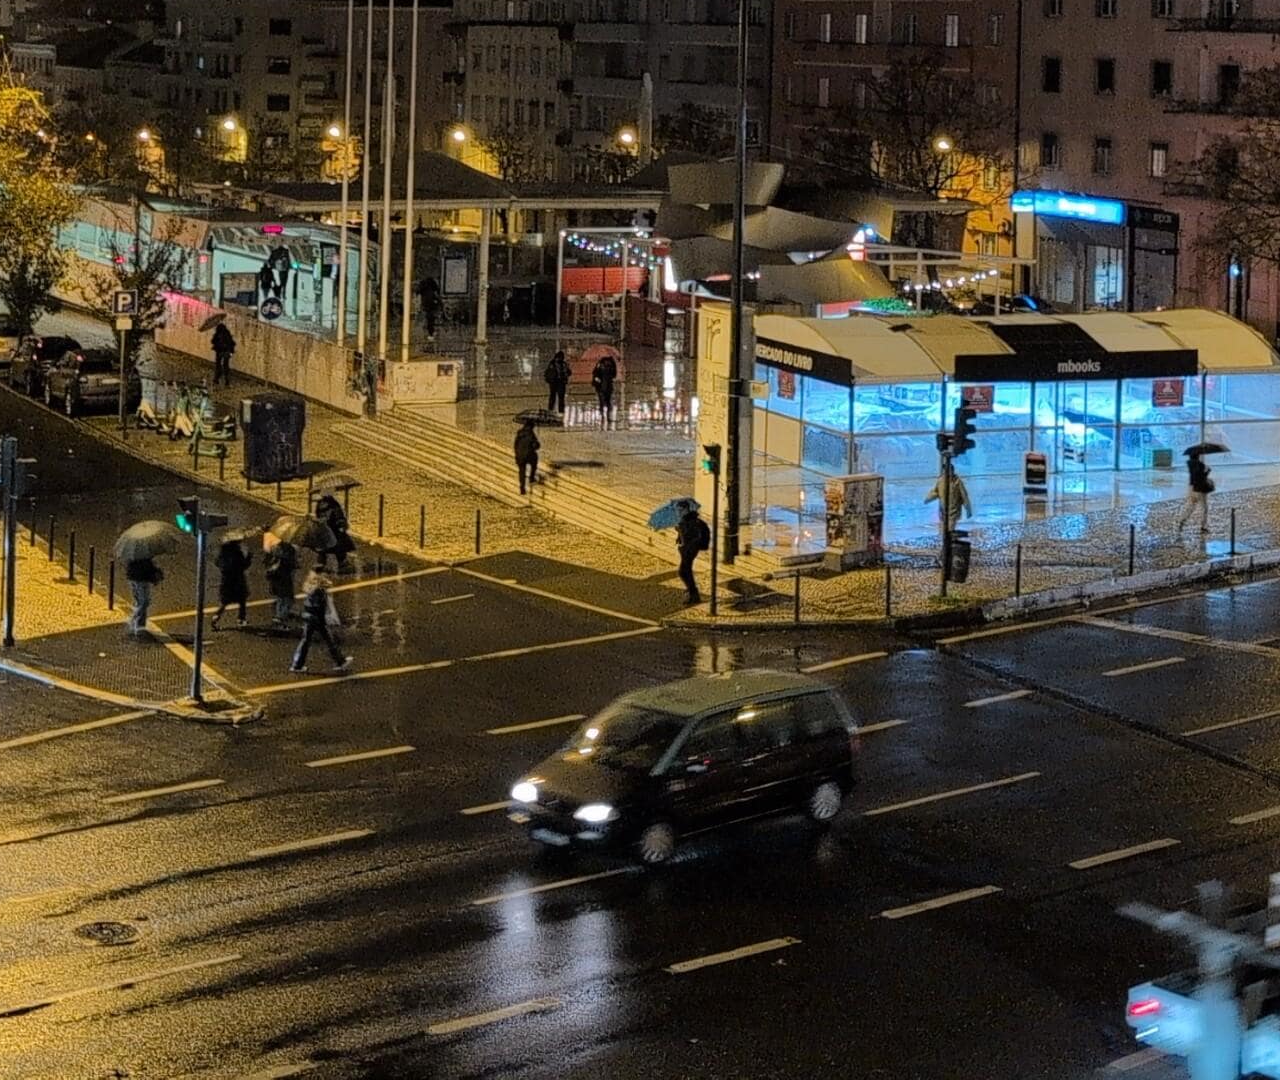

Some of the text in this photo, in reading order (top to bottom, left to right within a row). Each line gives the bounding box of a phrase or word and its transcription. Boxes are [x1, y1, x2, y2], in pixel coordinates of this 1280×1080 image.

[117, 293, 132, 312] P
[783, 350, 794, 366] DO
[1056, 359, 1102, 374] mbooks
